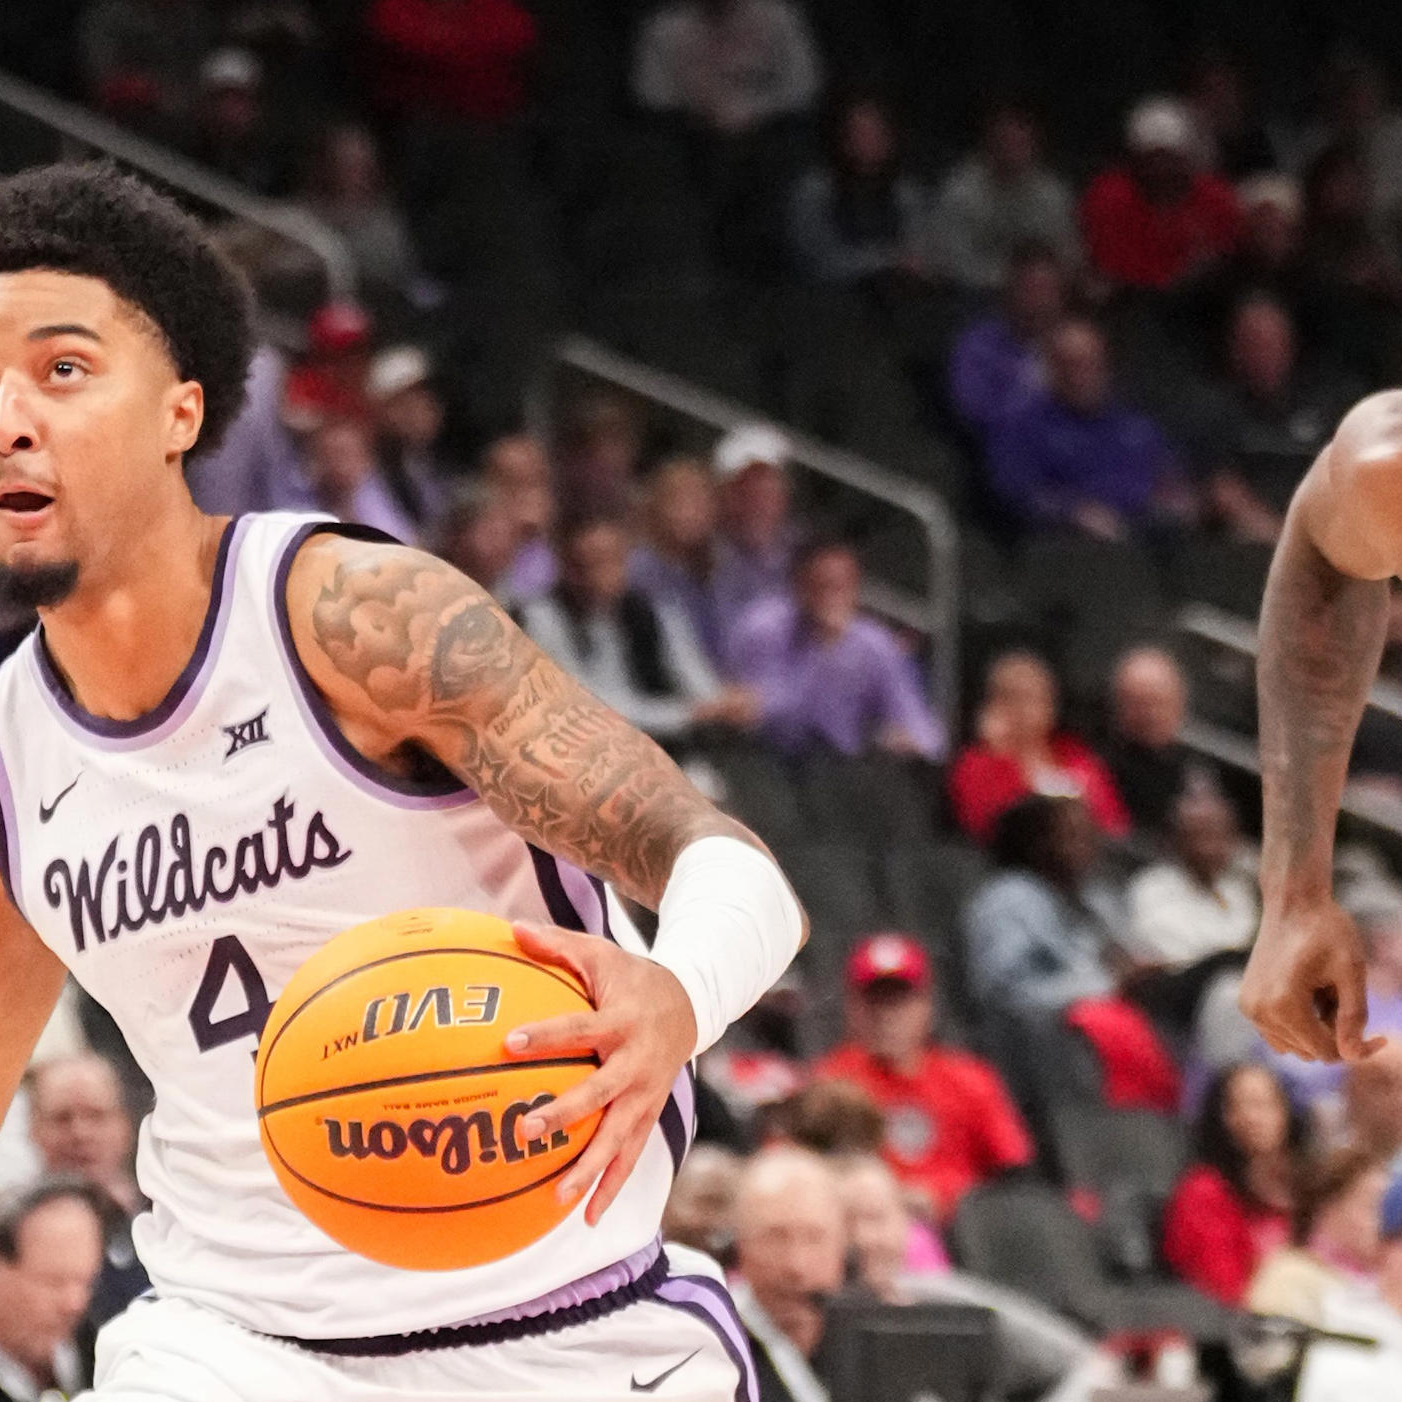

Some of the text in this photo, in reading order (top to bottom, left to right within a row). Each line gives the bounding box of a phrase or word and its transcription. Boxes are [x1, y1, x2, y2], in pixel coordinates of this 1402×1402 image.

[43, 791, 353, 952] Wildcats
[187, 933, 278, 1070] 4
[319, 984, 502, 1061] EVO NXT
[382, 1103, 411, 1111] BALL
